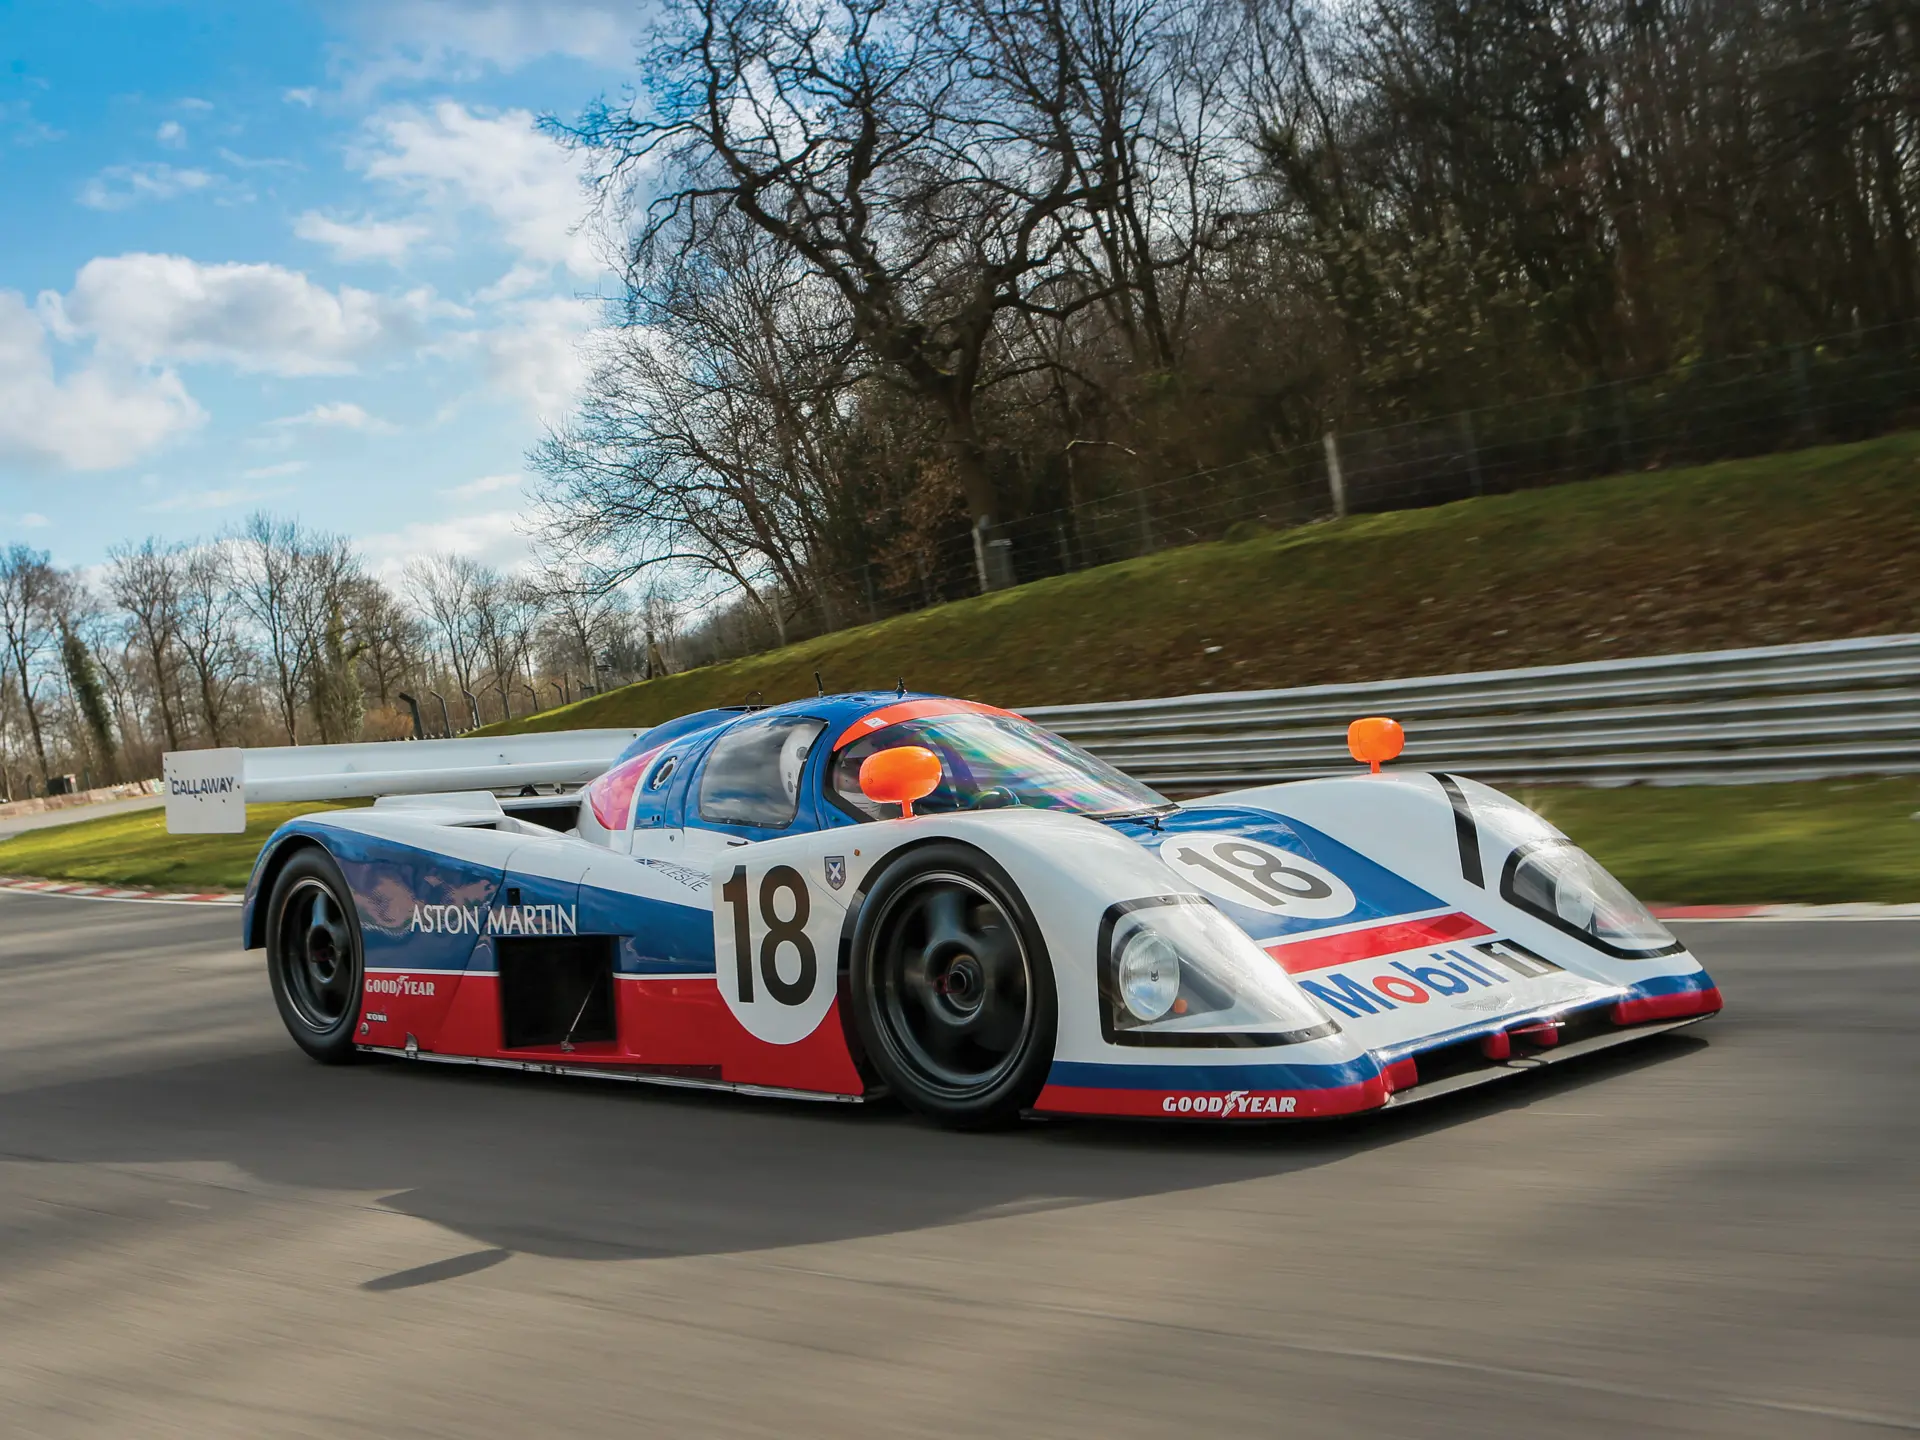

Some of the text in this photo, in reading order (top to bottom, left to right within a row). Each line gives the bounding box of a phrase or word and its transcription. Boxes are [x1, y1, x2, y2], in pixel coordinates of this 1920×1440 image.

[171, 777, 234, 795] CALLAWAY
[1176, 842, 1333, 907] 18
[410, 904, 577, 936] ASTON MARTIN
[722, 864, 817, 1006] 18
[1297, 942, 1549, 1019] Mobil 1
